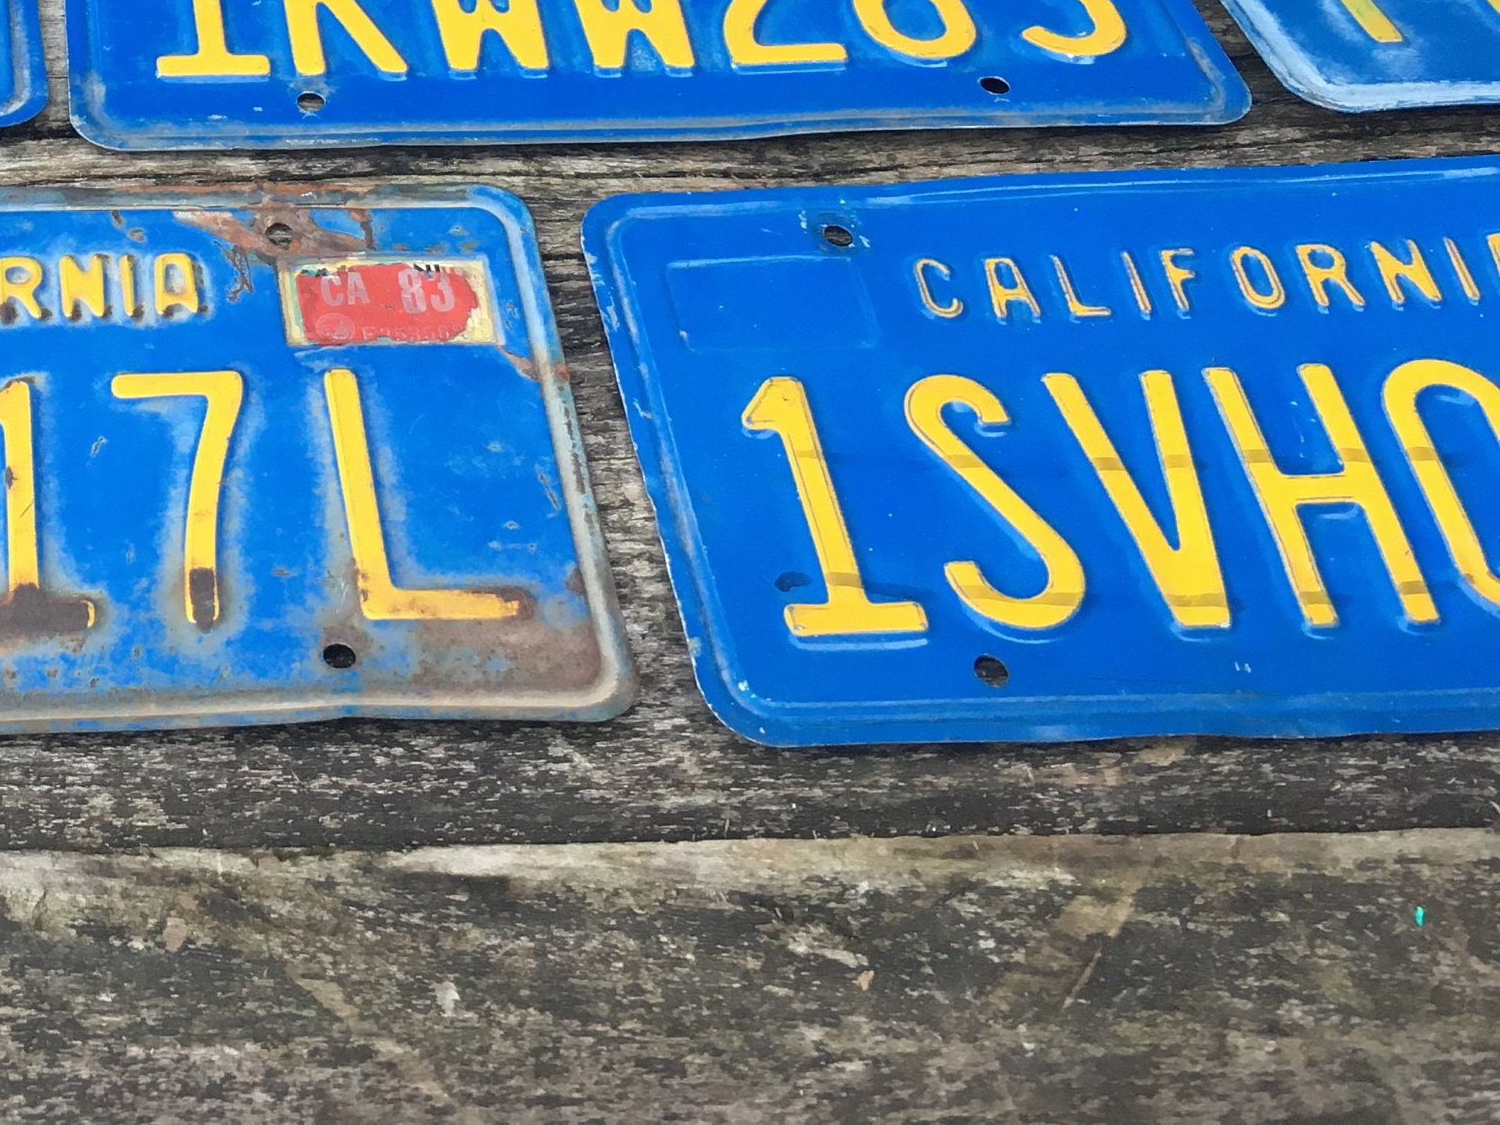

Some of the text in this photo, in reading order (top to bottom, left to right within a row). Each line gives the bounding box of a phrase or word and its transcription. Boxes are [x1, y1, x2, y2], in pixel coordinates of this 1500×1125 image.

[321, 271, 370, 306] CA
[915, 230, 1500, 318] CALIFORNI
[324, 368, 530, 621] L
